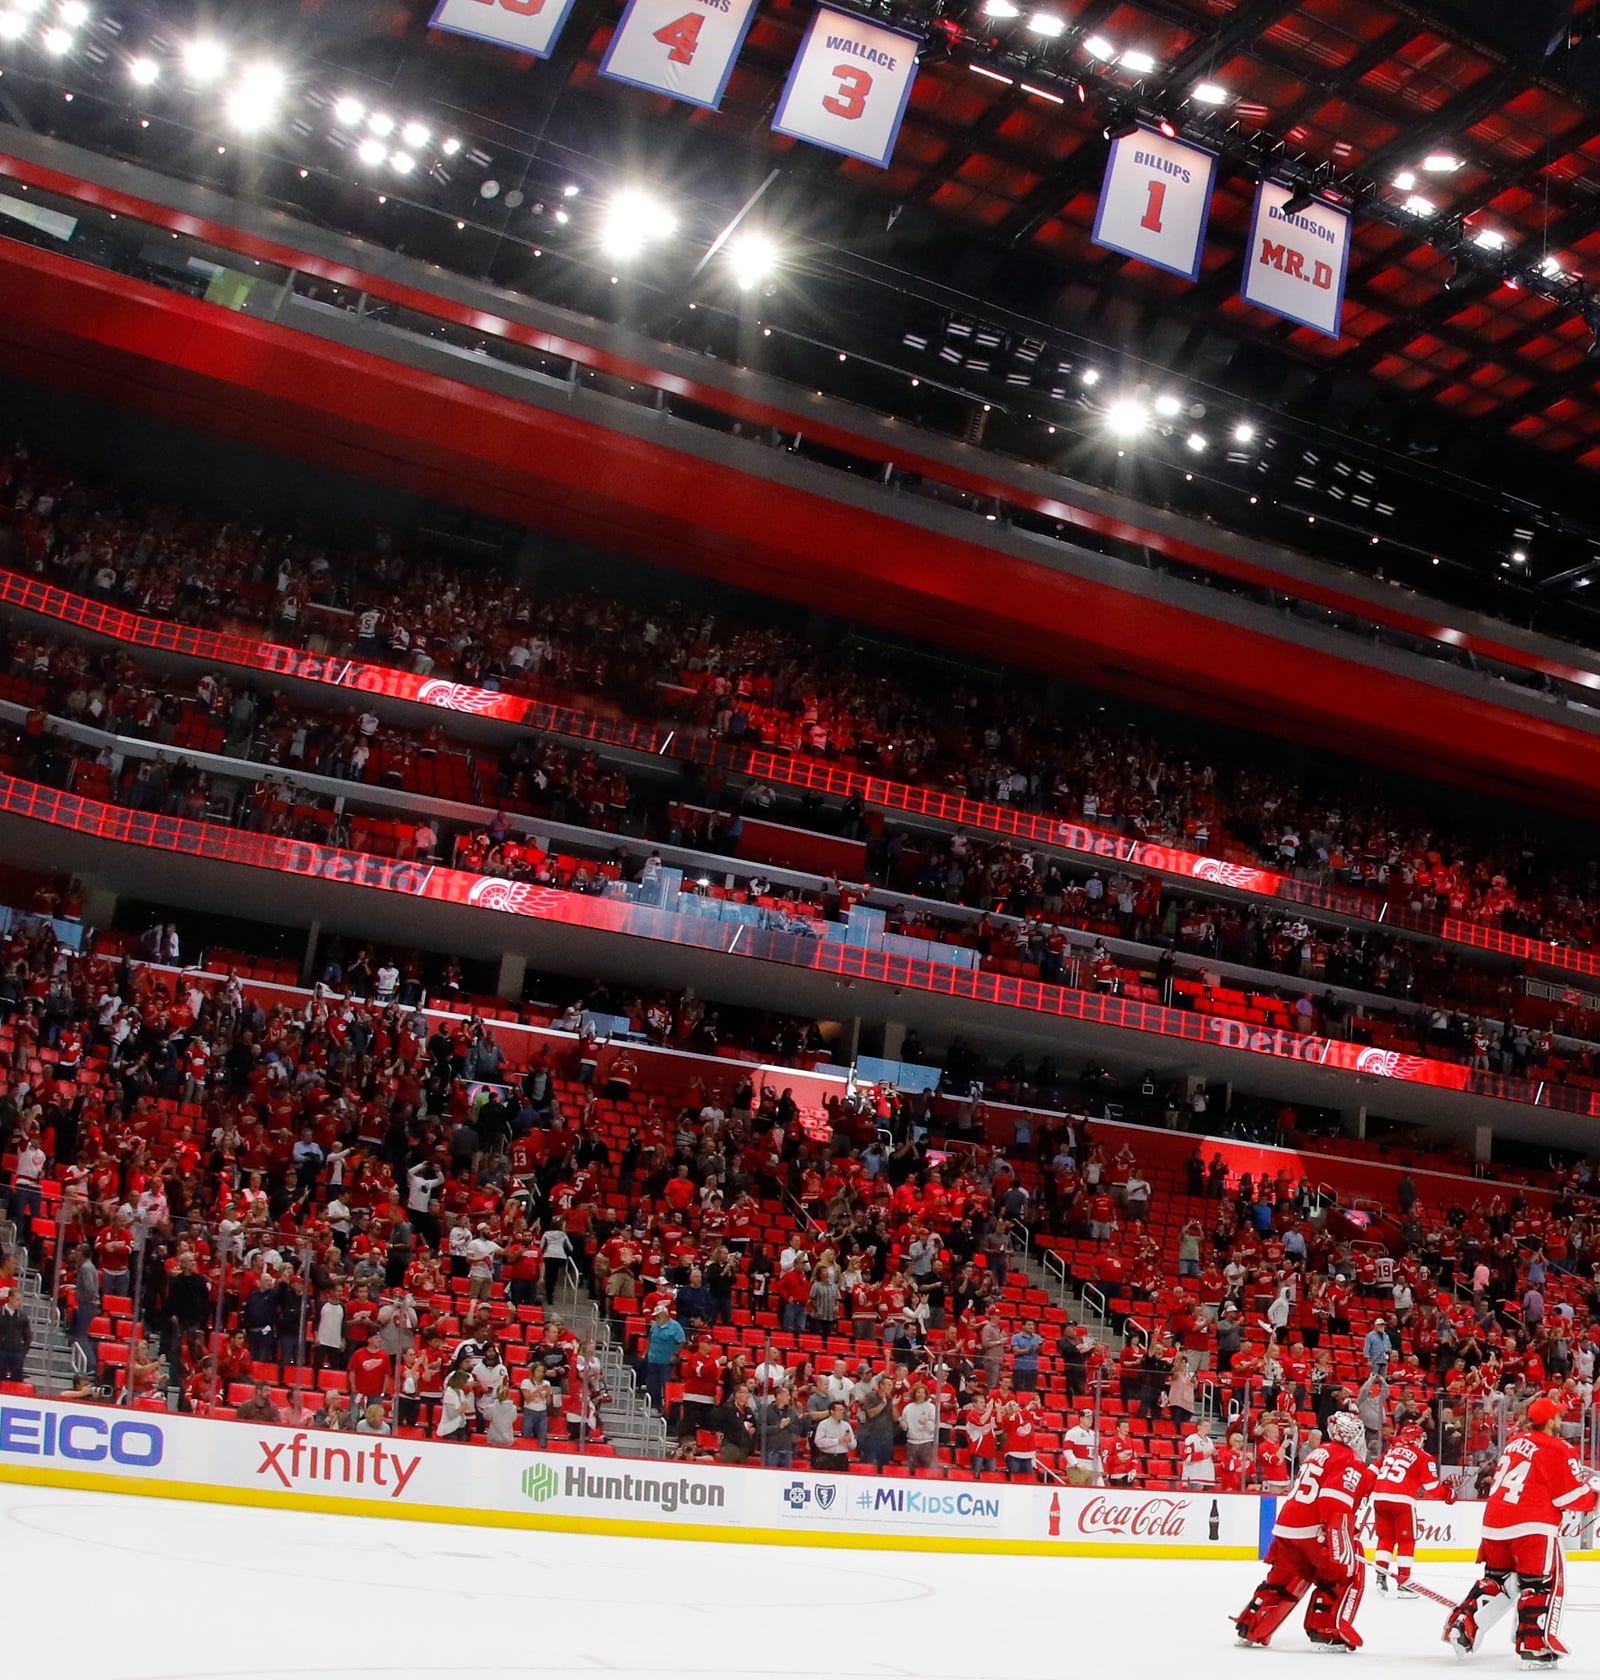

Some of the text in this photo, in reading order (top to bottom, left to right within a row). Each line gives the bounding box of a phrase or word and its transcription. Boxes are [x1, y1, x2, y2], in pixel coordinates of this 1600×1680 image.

[653, 12, 706, 66] 4
[826, 35, 896, 72] WALLACE
[822, 63, 873, 121] 3
[1133, 150, 1191, 184] BILLUPS
[1140, 180, 1167, 233] 1
[1268, 205, 1336, 244] DAVIDSON
[1259, 238, 1333, 291] MR.D
[1378, 1264, 1391, 1278] 19
[256, 1433, 422, 1498] xfinity
[1342, 1466, 1363, 1487] 35
[564, 1465, 725, 1513] Huntington
[1077, 1495, 1193, 1537] Coca-Cola
